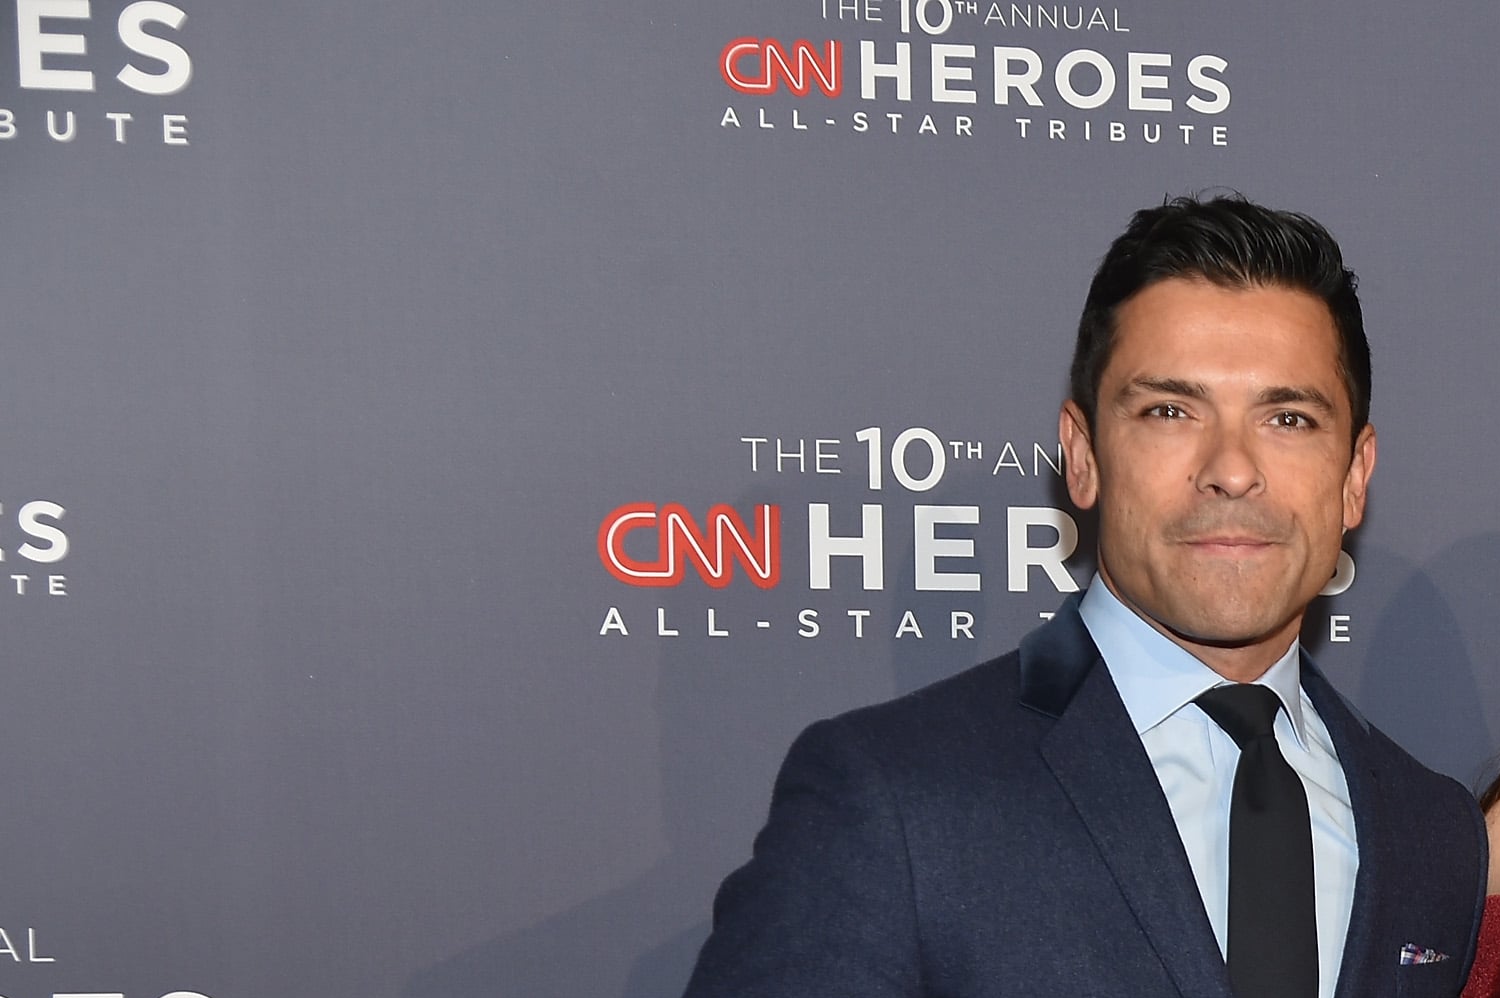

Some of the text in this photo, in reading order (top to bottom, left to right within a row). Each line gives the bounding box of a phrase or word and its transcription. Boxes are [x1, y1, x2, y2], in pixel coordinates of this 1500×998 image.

[984, 2, 1129, 32] ANNUAL
[719, 36, 1231, 115] CNN HEROES
[0, 109, 189, 145] BUTE
[721, 107, 1227, 145] ALL-STAR TRIBUTE
[741, 438, 840, 473] THE
[598, 502, 781, 590] CNN
[600, 607, 974, 638] ALL-STAR
